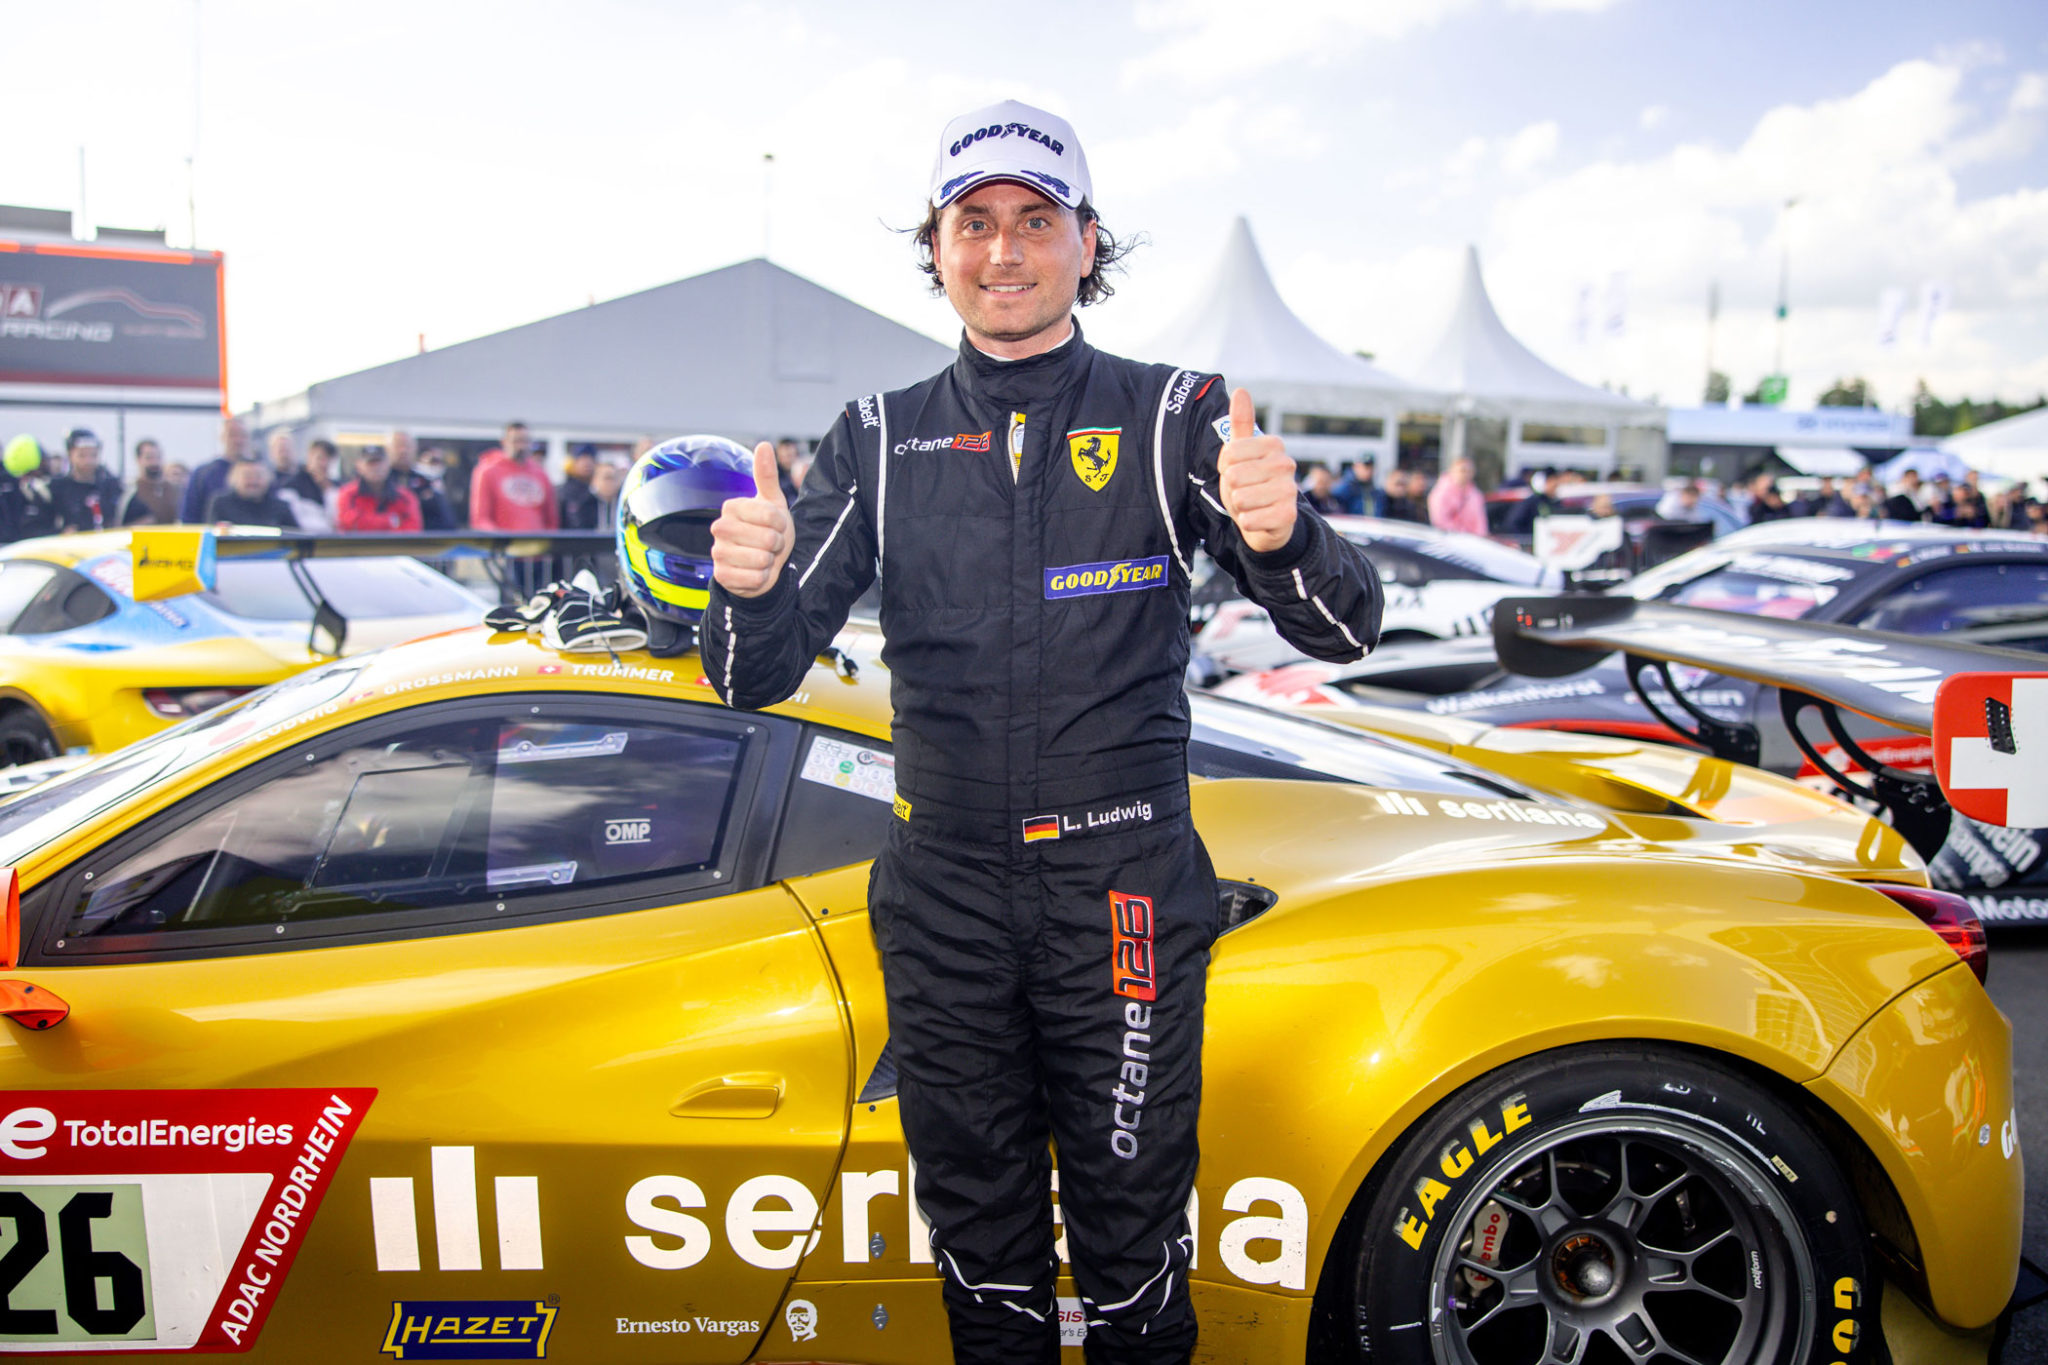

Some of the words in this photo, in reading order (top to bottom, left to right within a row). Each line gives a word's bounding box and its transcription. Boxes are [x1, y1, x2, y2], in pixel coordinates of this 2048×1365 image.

[950, 123, 1064, 157] GOODYEAR
[1166, 372, 1199, 415] Sabelt
[1050, 562, 1164, 591] GOODYEAR
[384, 666, 519, 695] GROSSMANN
[572, 664, 674, 683] TRUMMER
[1425, 679, 1606, 715] Walkenhorst
[1063, 816, 1082, 832] L.
[1087, 801, 1153, 827] Ludwig
[1438, 799, 1607, 830] serliana
[605, 822, 651, 841] OMP
[1967, 893, 2048, 922] Moto
[63, 1117, 294, 1153] TotalEnergies
[1393, 1091, 1533, 1251] EAGLE
[220, 1263, 272, 1346] ADAC
[255, 1094, 353, 1267] NORDRHEIN
[1474, 1213, 1501, 1282] embo
[1750, 1250, 1762, 1289] rotiform
[401, 1316, 540, 1344] HAZET
[616, 1317, 691, 1334] Ernesto
[693, 1316, 760, 1336] Vargas
